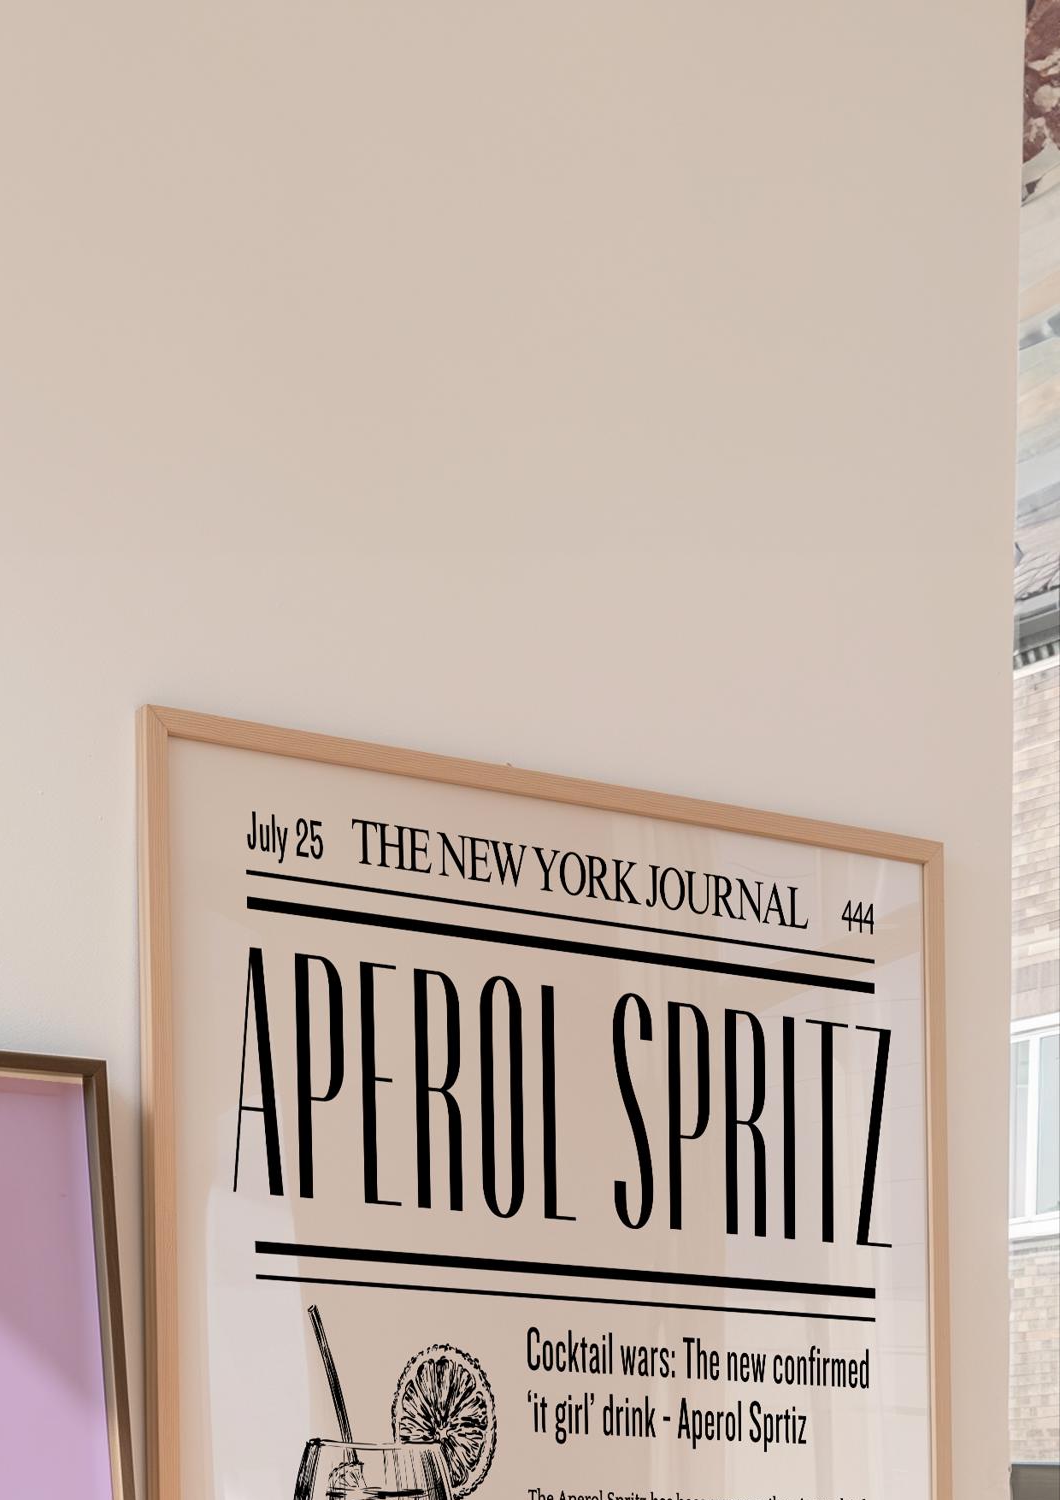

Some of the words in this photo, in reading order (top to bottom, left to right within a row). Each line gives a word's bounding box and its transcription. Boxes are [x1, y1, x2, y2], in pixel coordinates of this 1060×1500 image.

[246, 810, 289, 864] July
[295, 817, 324, 860] 25
[351, 818, 433, 874] THE
[436, 831, 528, 888] NEW
[531, 846, 642, 906] YORK
[645, 864, 809, 930] JOURNAL
[841, 899, 875, 935] 444
[232, 946, 577, 1222] APEROL
[612, 992, 893, 1249] SPRITZ
[526, 1326, 613, 1375] Cocktail
[619, 1344, 676, 1379] wars:
[682, 1336, 720, 1381] The
[726, 1351, 767, 1383] new
[773, 1345, 870, 1390] confirmed
[602, 1393, 657, 1438] drink
[677, 1397, 742, 1450] Aperol
[749, 1400, 807, 1453] Sprtiz
